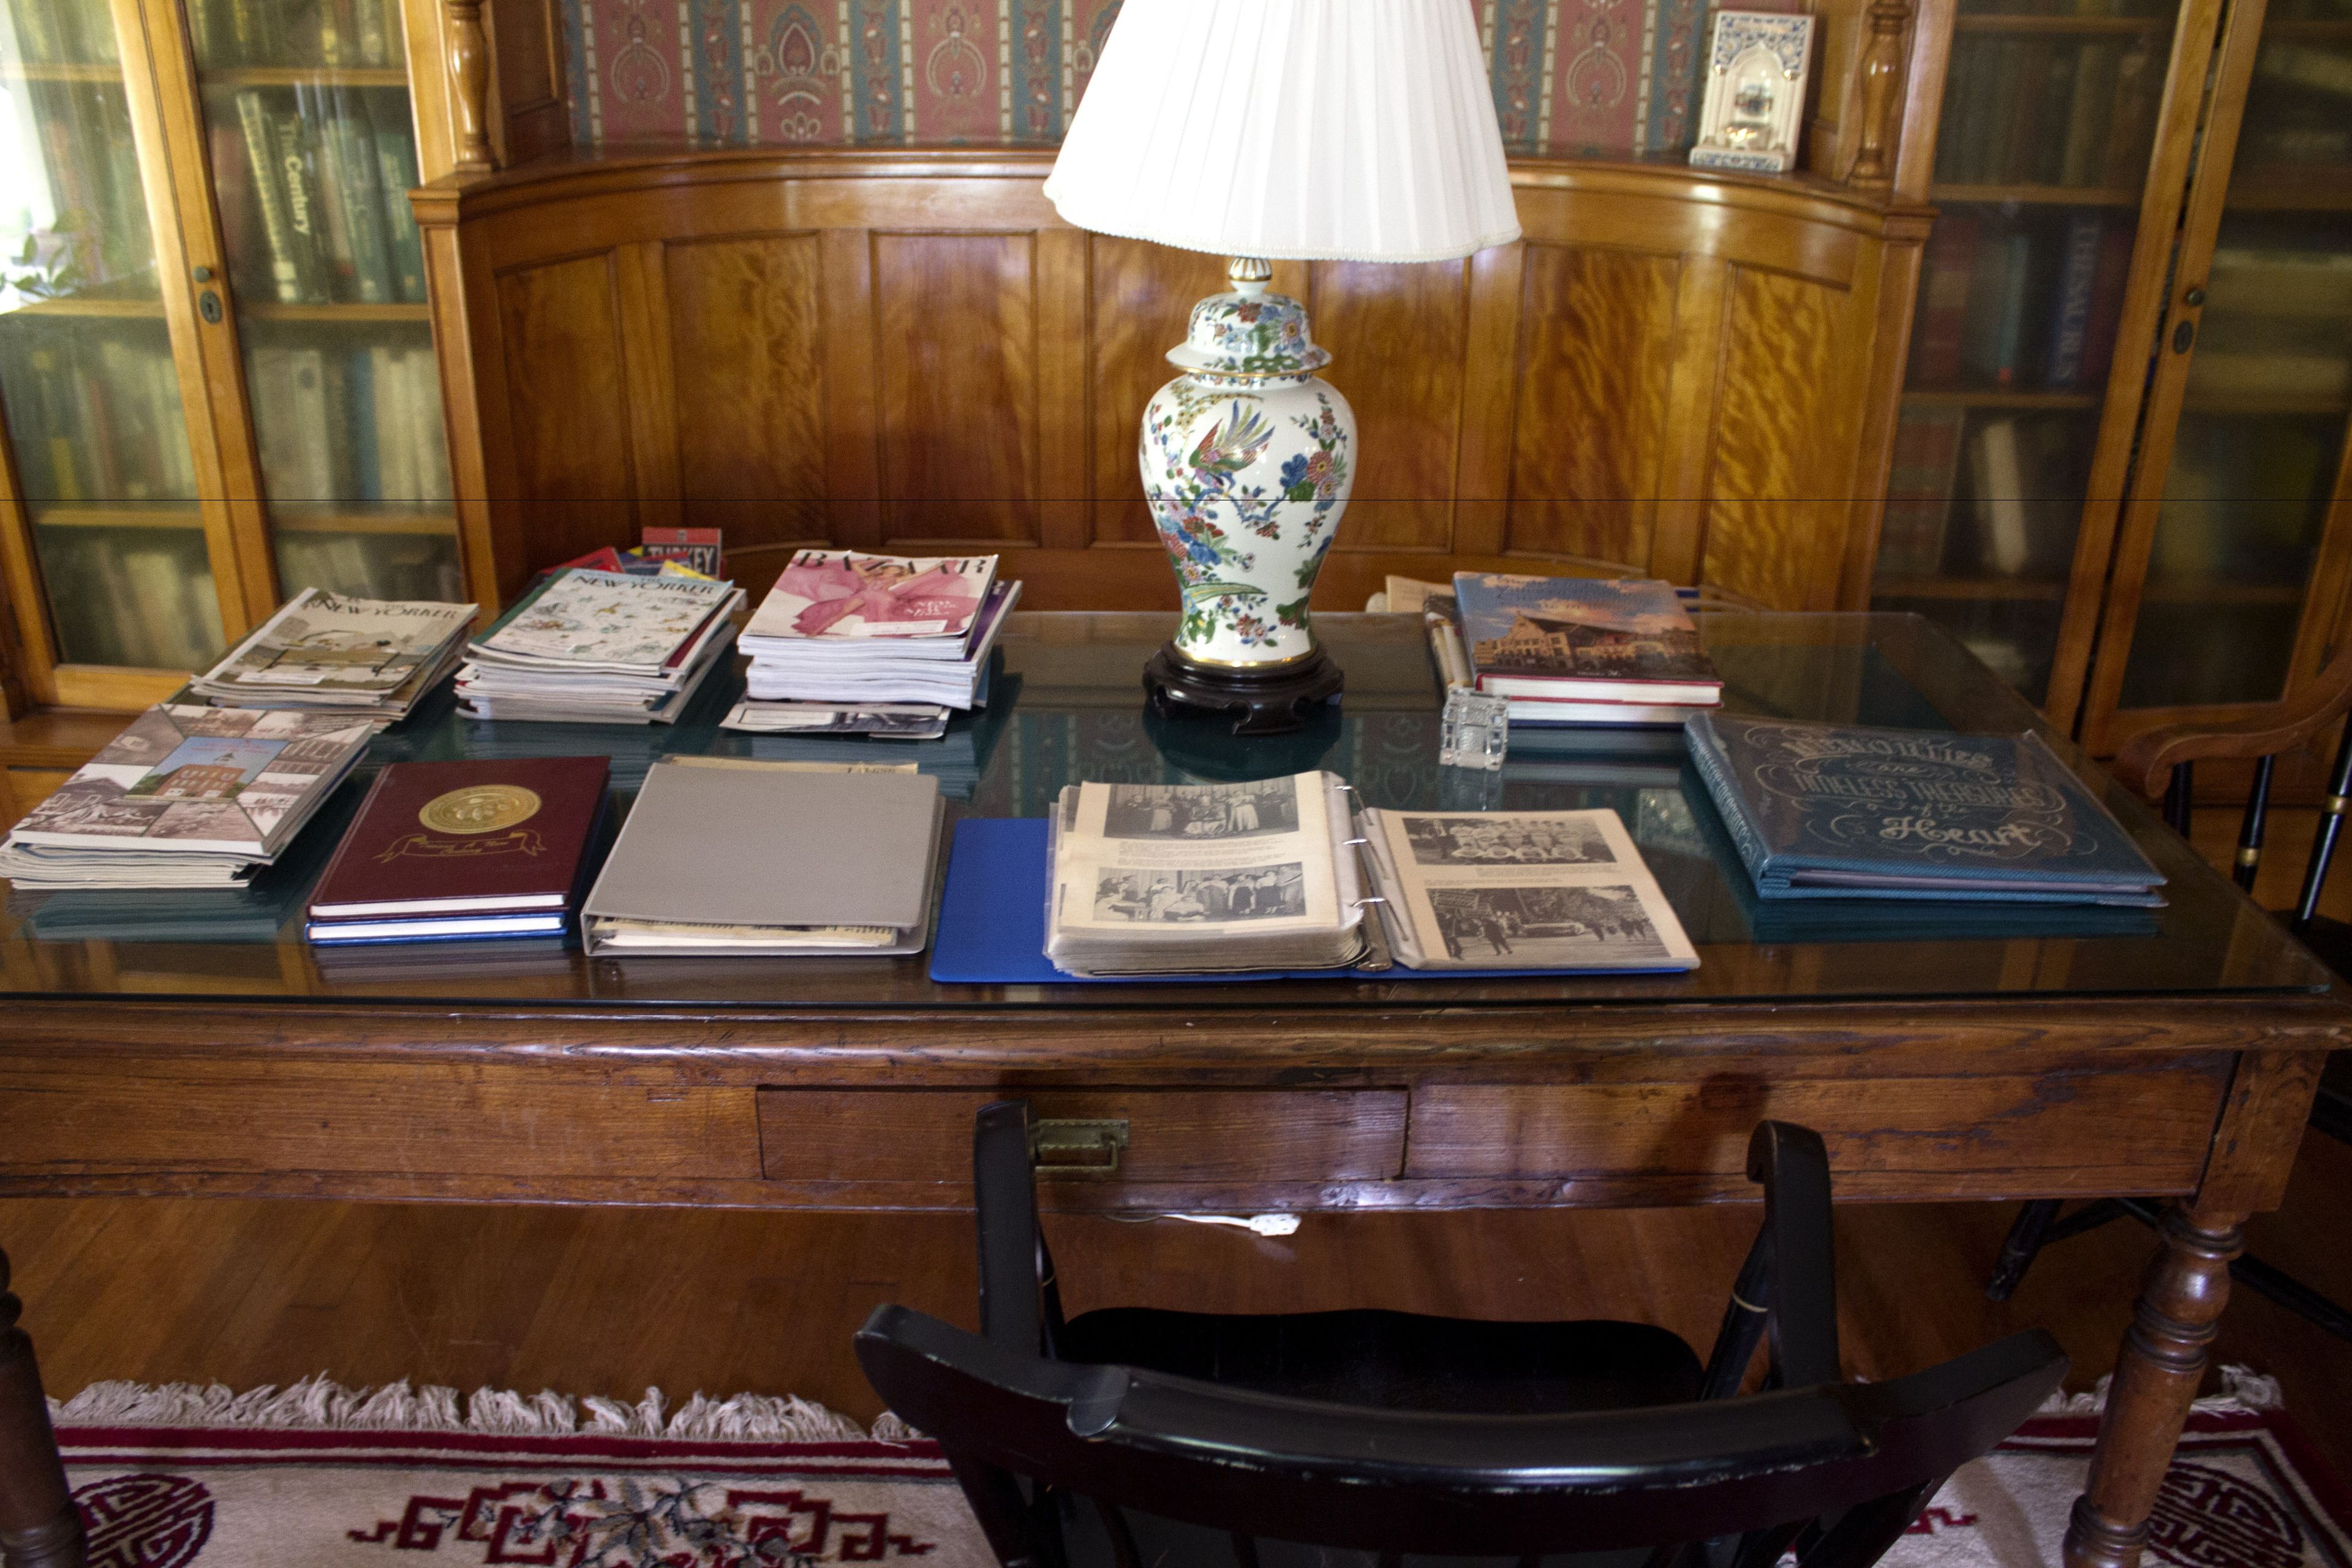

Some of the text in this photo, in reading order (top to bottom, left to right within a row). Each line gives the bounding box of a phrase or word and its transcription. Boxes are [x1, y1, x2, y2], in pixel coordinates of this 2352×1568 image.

[284, 155, 311, 235] Century
[798, 552, 987, 575] BAZAAR
[573, 576, 714, 595] NEW YORKER
[314, 598, 458, 619] NEW YORKER
[1792, 773, 2045, 808] TIMELESS TREASURES
[1879, 815, 2042, 846] Heart
